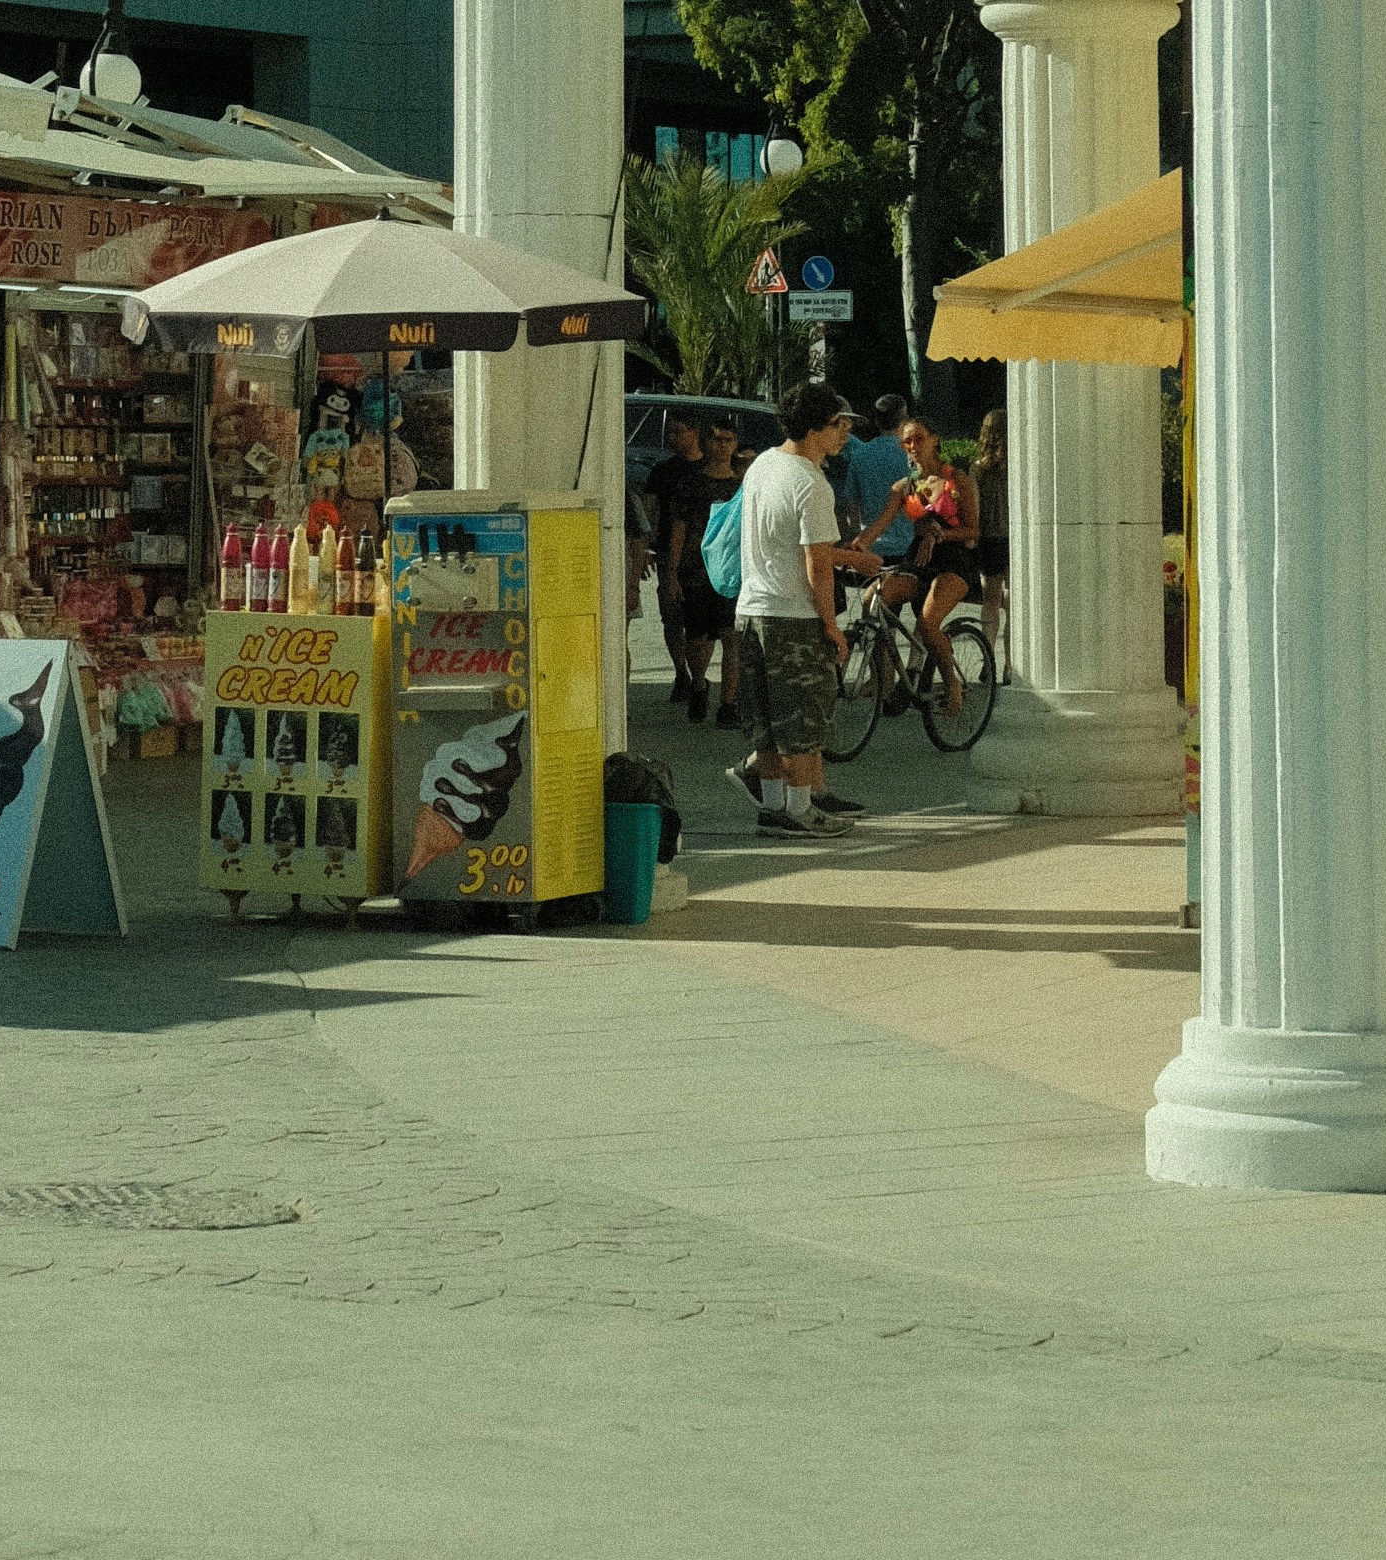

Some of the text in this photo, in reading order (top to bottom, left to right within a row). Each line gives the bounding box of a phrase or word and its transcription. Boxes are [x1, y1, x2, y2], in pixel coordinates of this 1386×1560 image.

[10, 241, 63, 267] ROSE
[429, 613, 487, 639] ICE
[503, 553, 527, 711] CHOCO
[407, 647, 512, 675] CREAM
[216, 664, 360, 709] CREAM
